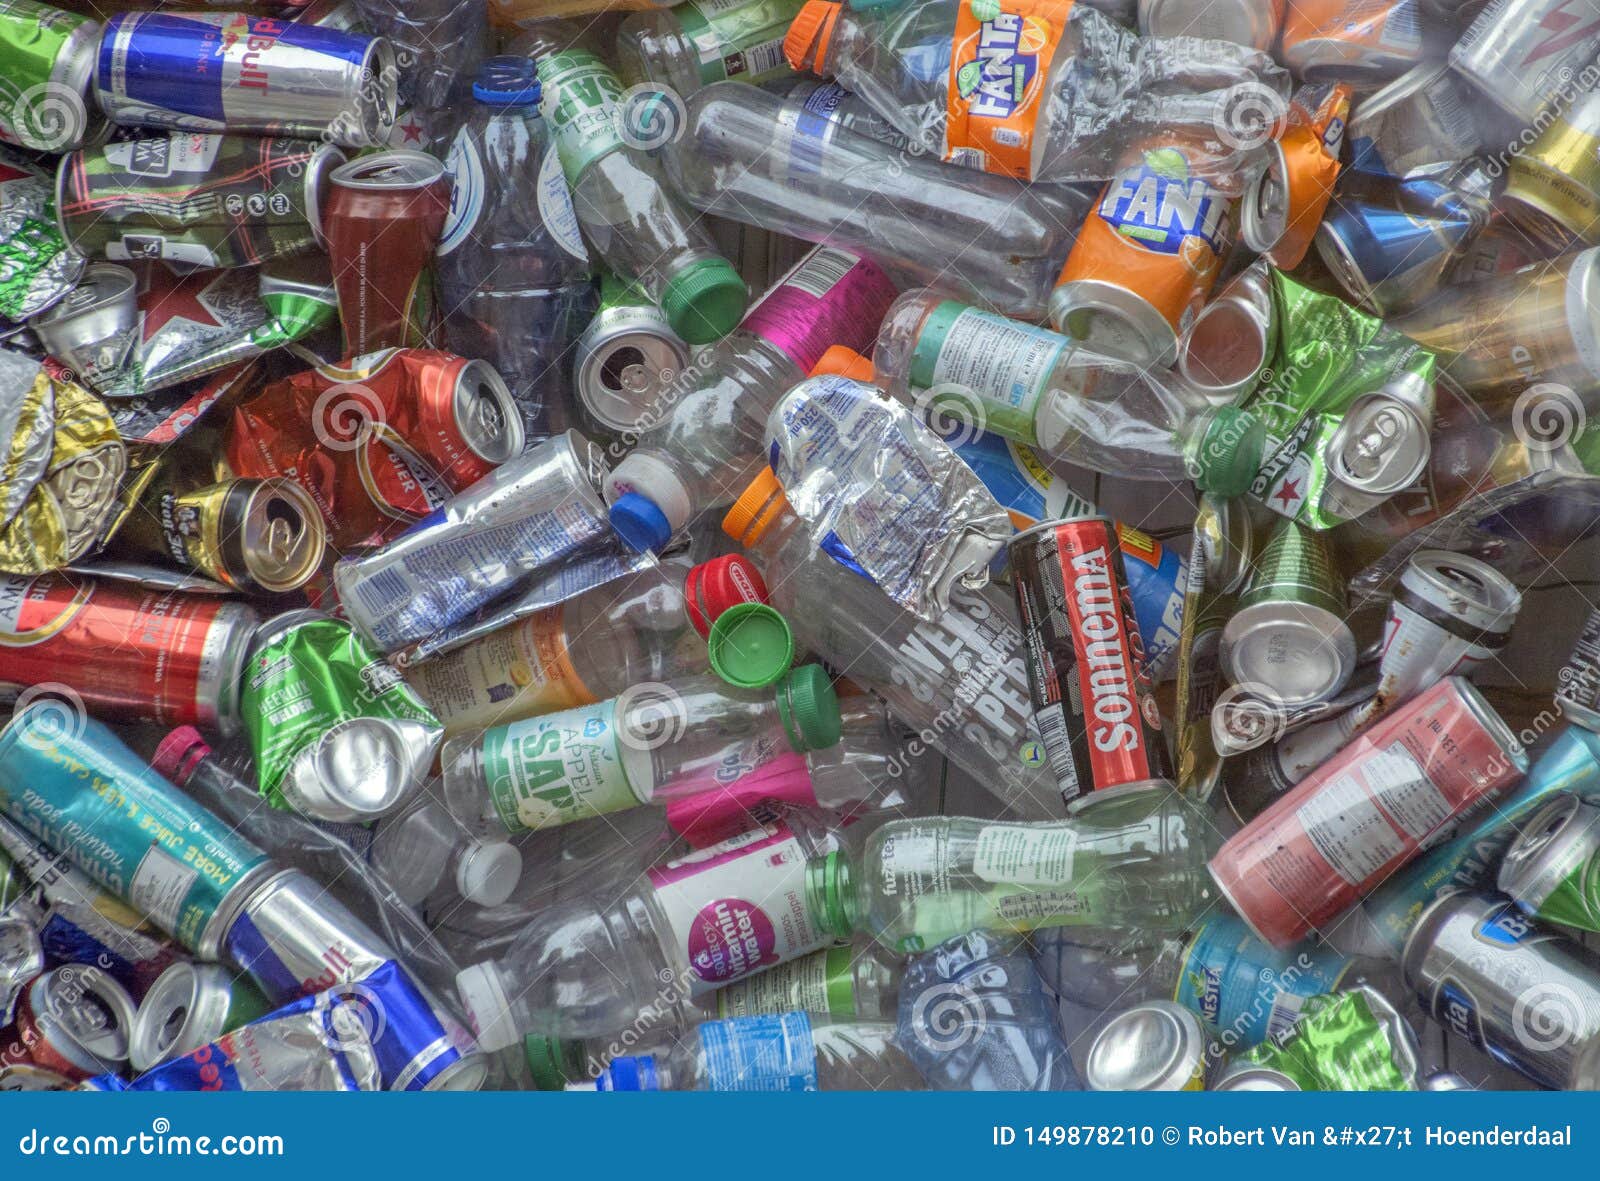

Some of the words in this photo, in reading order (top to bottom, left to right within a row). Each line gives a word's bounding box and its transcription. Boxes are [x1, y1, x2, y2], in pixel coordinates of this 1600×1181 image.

[239, 34, 277, 90] Bull
[969, 14, 1022, 118] FANTA
[798, 406, 821, 427] 250
[387, 453, 417, 495] BIER
[519, 729, 574, 813] SAP
[561, 727, 593, 802] APPEL
[18, 787, 63, 826] soda
[137, 812, 185, 853] JUICE
[60, 817, 129, 873] natural
[181, 845, 230, 886] MORE
[720, 902, 748, 978] vitamin
[734, 909, 762, 964] water
[1204, 966, 1224, 1026] NESTEA
